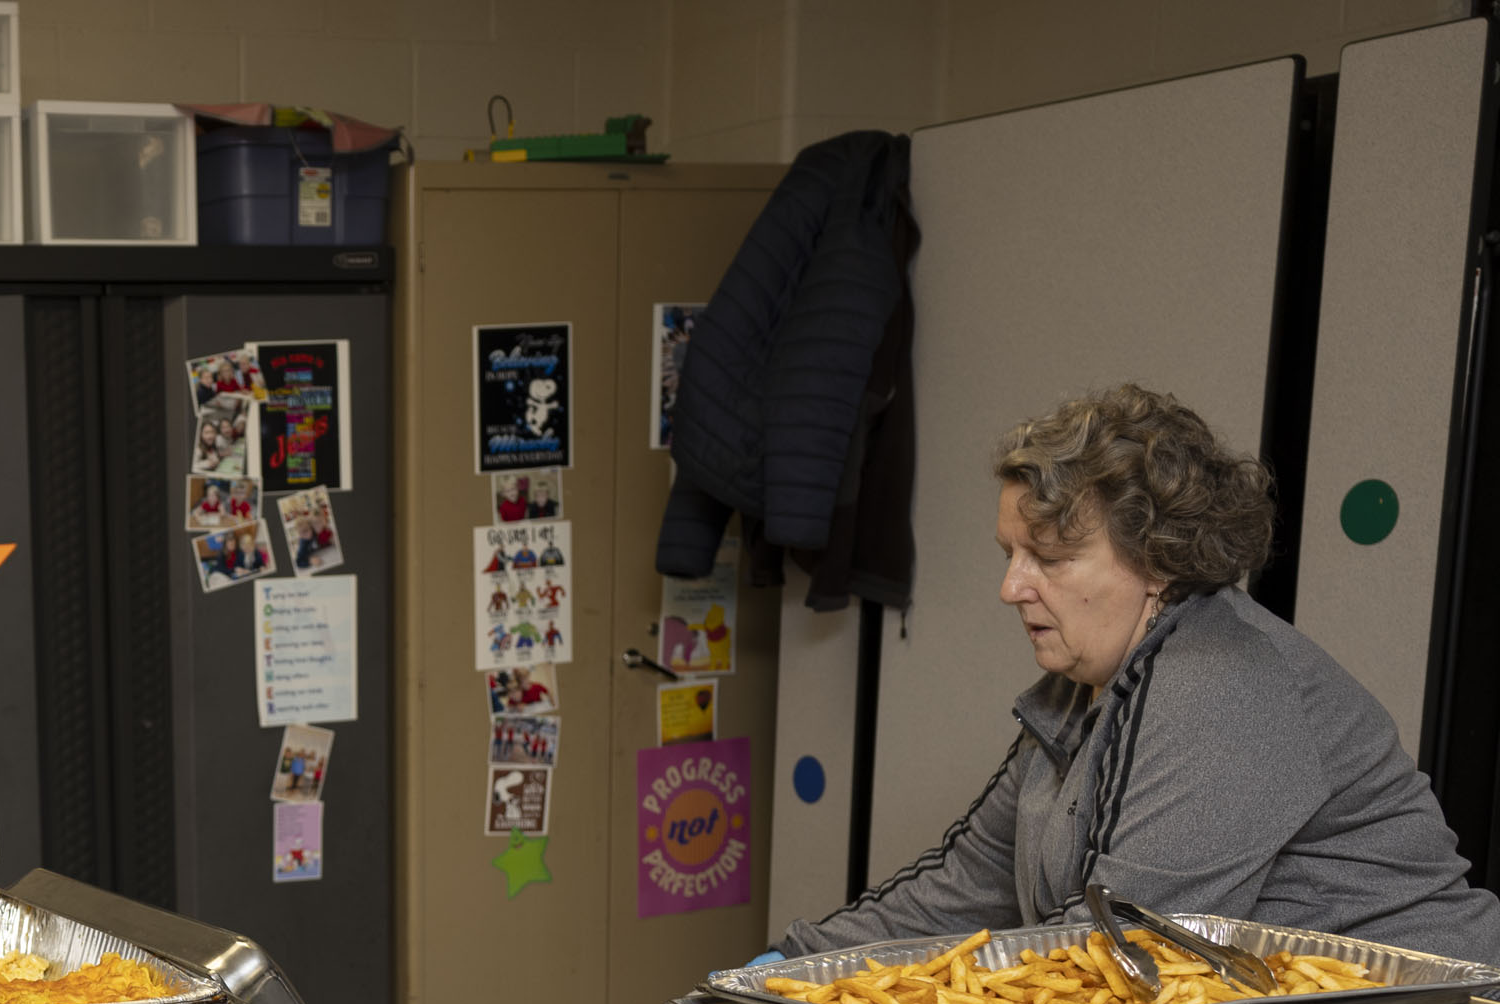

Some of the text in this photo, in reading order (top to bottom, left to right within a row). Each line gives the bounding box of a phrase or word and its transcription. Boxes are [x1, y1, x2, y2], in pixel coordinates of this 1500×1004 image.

[642, 756, 746, 815] PROGRESS
[668, 807, 720, 846] not
[642, 838, 747, 898] PERFECTION
